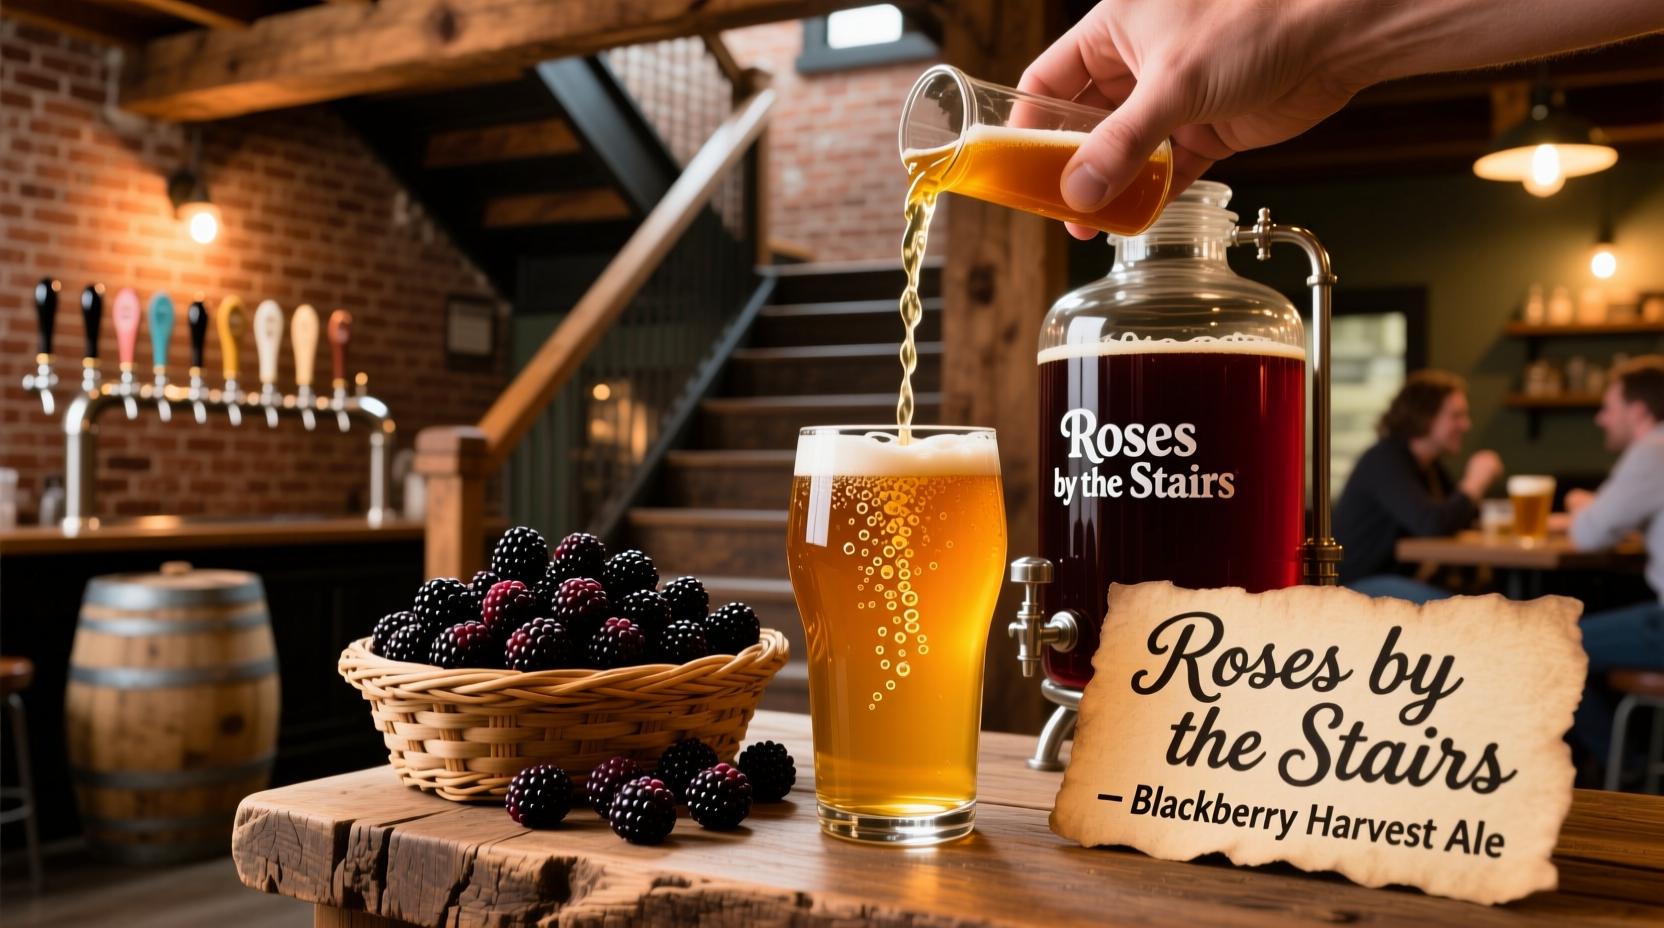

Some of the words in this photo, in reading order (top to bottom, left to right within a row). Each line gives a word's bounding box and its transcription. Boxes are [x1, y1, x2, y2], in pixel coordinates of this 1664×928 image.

[1060, 408, 1197, 464] Roses
[1054, 467, 1077, 506] by
[1081, 466, 1123, 498] the
[1130, 461, 1235, 499] Stairs
[1130, 611, 1353, 702] Roses
[1368, 625, 1464, 726] by
[1165, 706, 1266, 772] the
[1278, 702, 1518, 794] Stairs
[1130, 784, 1298, 841] Blackberry
[1306, 804, 1438, 850] Harvest
[1444, 819, 1505, 858] Ale
